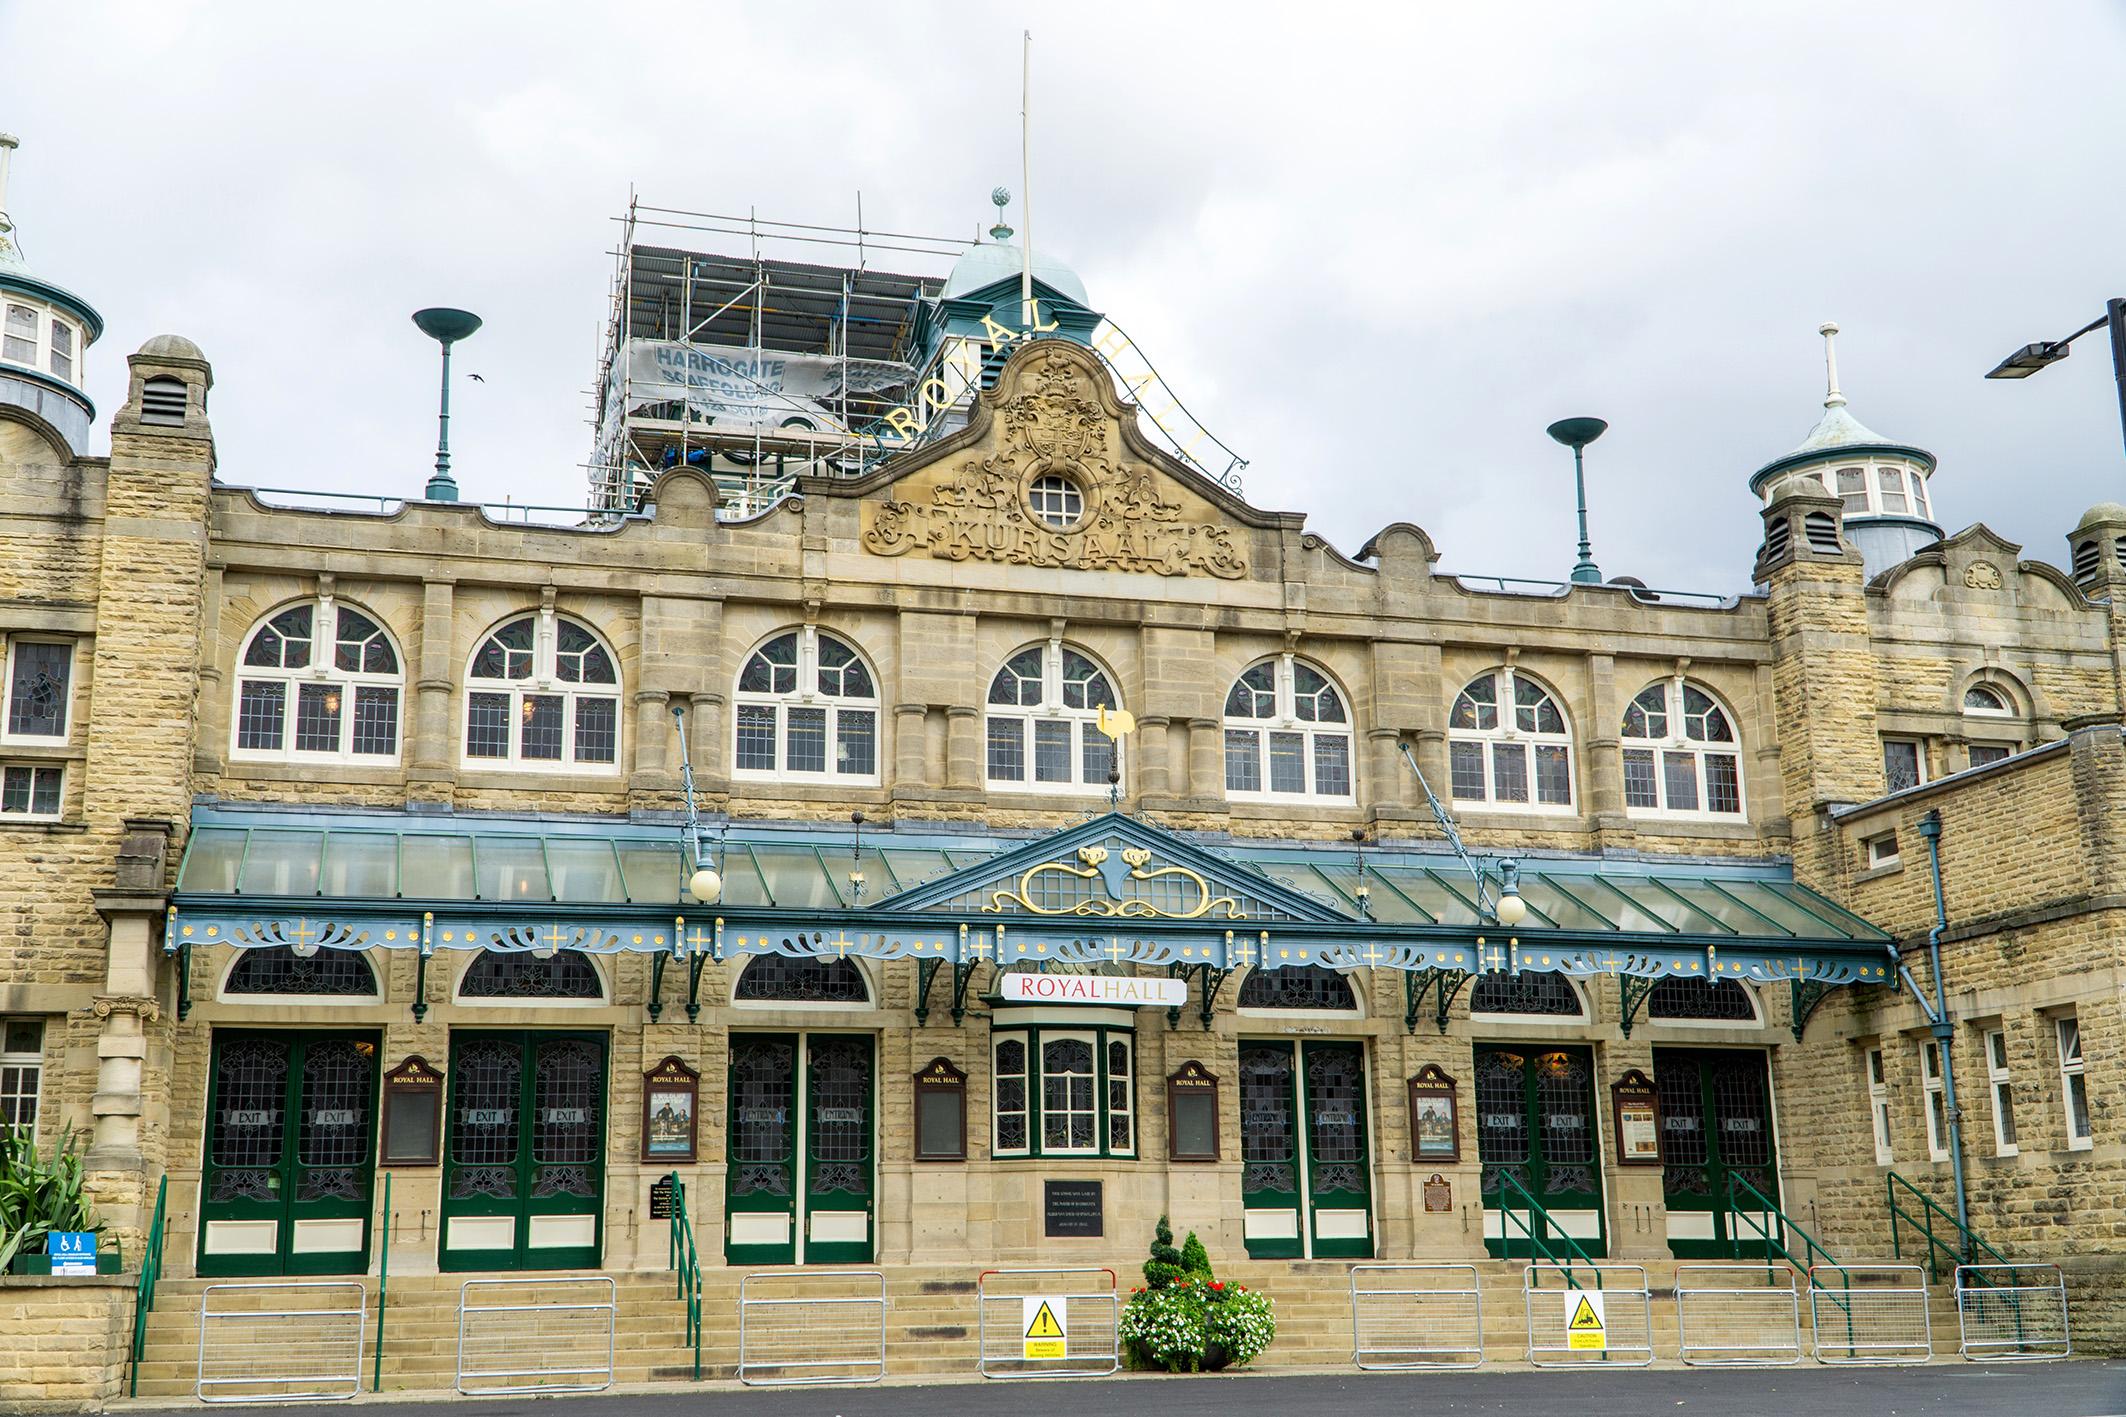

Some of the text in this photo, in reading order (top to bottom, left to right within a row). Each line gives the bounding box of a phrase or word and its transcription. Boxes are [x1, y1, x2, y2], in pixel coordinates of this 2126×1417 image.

[656, 347, 786, 380] HARROGATE
[662, 369, 780, 400] SCAFFOLDNG
[884, 299, 1207, 462] ROYAL HALL
[1021, 977, 1168, 1001] ROYAL HALL
[239, 1113, 261, 1123] EXIT
[324, 1112, 346, 1122] EXIT
[476, 1111, 497, 1122] EXIT
[556, 1110, 577, 1121] EXIT
[1493, 1116, 1509, 1125] EXIT
[1556, 1117, 1573, 1126] EXIT
[1671, 1119, 1687, 1128] EXIT
[1733, 1120, 1749, 1129] EXIT
